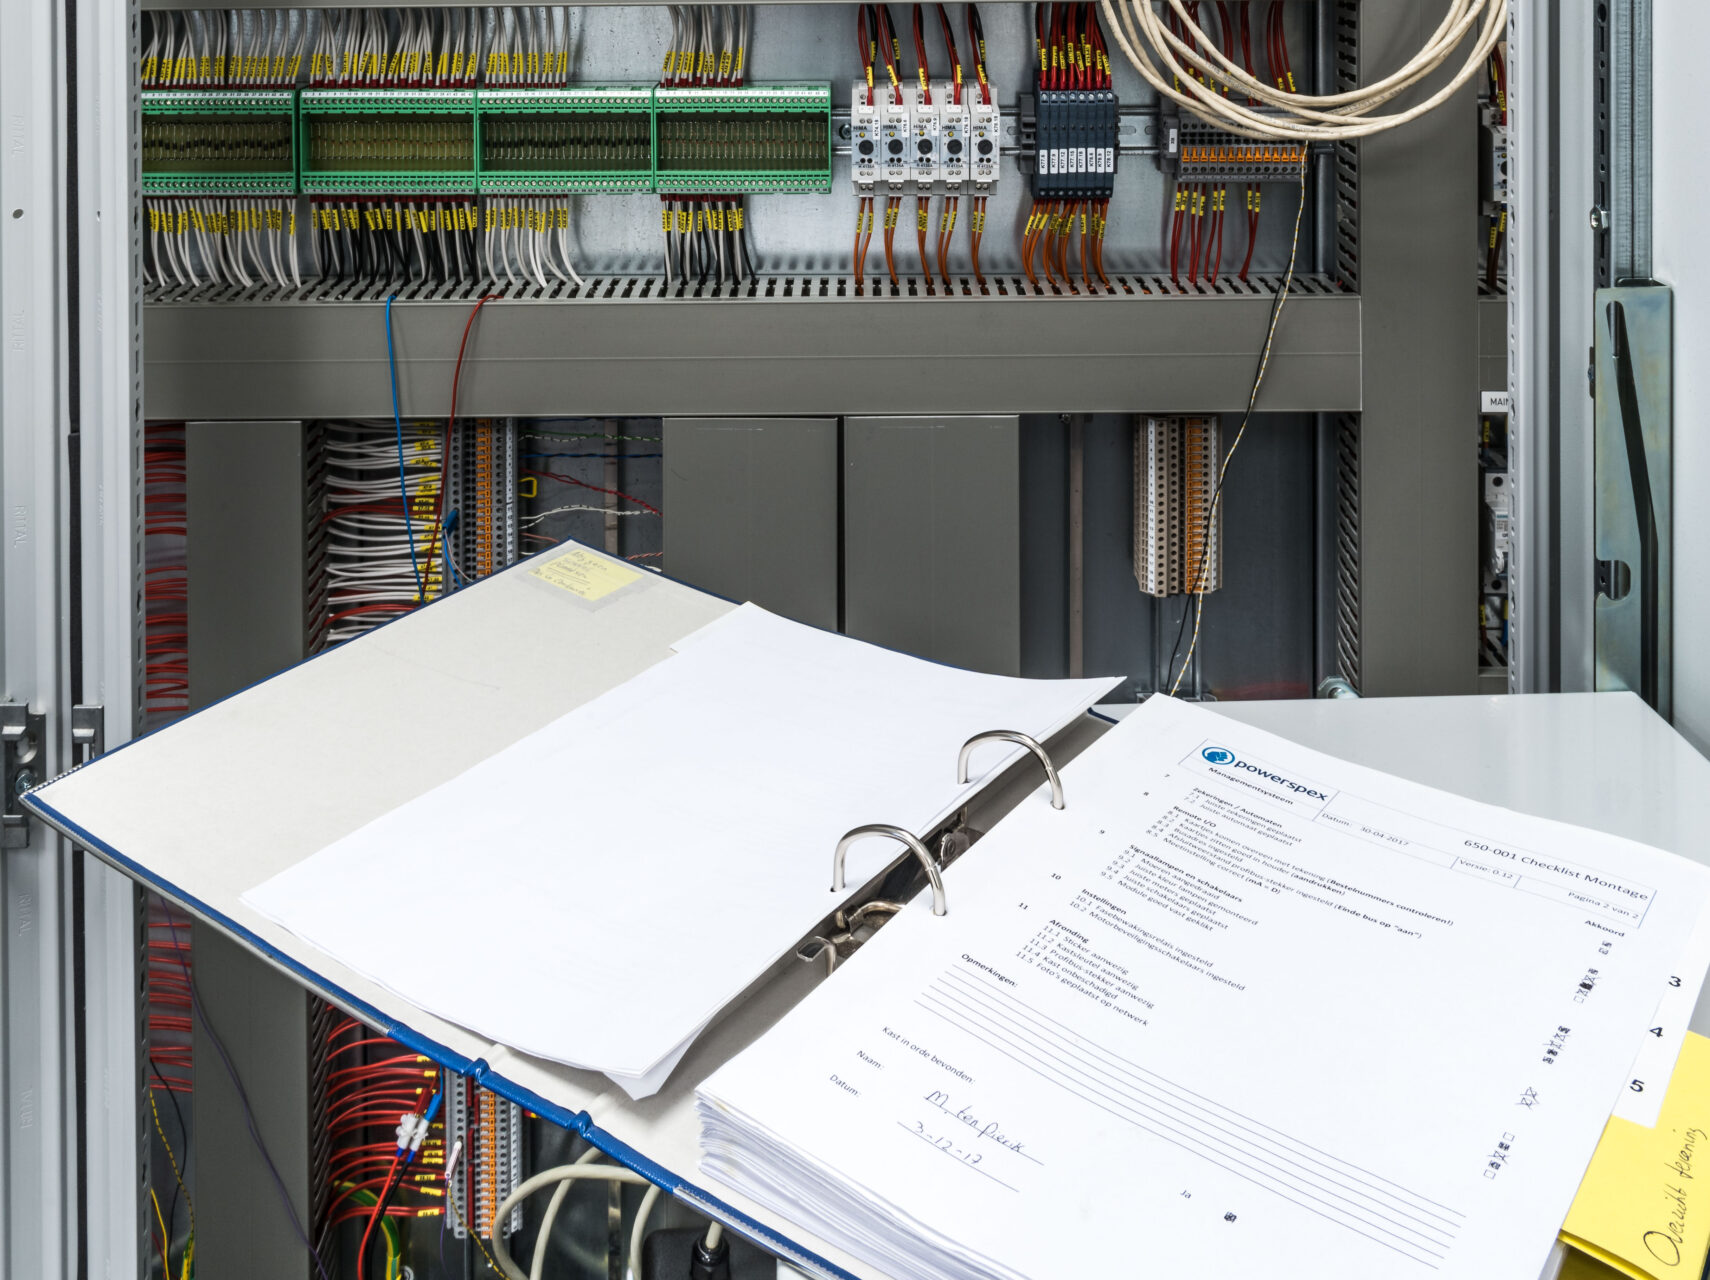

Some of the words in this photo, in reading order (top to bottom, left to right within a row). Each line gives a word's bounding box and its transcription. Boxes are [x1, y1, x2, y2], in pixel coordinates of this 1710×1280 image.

[1207, 766, 1293, 805] Managementsysteem
[1233, 759, 1328, 801] powerspex
[1172, 805, 1202, 821] Remote
[1202, 818, 1217, 828] I/O
[1192, 786, 1233, 807] Zekeringen
[1239, 807, 1282, 828] Automaten
[1321, 812, 1352, 826] Datum:
[1128, 843, 1184, 874] Signaallampen
[1196, 877, 1242, 903] schakelaars
[1140, 857, 1171, 876] Moeren
[1171, 874, 1220, 900] aangedraaid
[1459, 858, 1488, 871] Versie:
[1491, 869, 1513, 879] 0.12
[1463, 839, 1516, 860] 650-001
[1520, 856, 1580, 878] Checklist
[1583, 873, 1648, 899] Montage
[1080, 888, 1127, 915] Instellingen
[1116, 879, 1148, 898] Module
[1146, 896, 1169, 909] goed
[1168, 906, 1186, 918] vast
[1184, 915, 1214, 932] geklikt
[1122, 874, 1145, 887] Juiste
[1145, 886, 1190, 911] schakelaars
[1189, 909, 1229, 930] geplaatst
[1128, 869, 1151, 882] Juiste
[1150, 880, 1178, 897] meters
[1178, 895, 1216, 916] geplaatst
[1134, 863, 1157, 876] Juiste
[1157, 874, 1177, 887] kleur
[1177, 884, 1207, 903] lampen
[1206, 900, 1259, 926] gemonteerd
[1567, 890, 1601, 906] Pagina
[1611, 906, 1630, 916] van
[1048, 918, 1089, 944] Afronding
[1068, 900, 1087, 912] 10.2
[1088, 910, 1204, 974] Motorbeveiligingsschakelaars
[1205, 970, 1246, 991] ingesteld
[1075, 894, 1093, 906] 10.1
[1095, 904, 1173, 949] Fasebewakingsrelais
[1174, 946, 1214, 968] ingesteld
[1584, 919, 1625, 937] Akkoord
[960, 953, 1018, 987] Opmerkingen:
[1035, 931, 1055, 943] 11.2
[1055, 942, 1101, 969] Kastsleutel
[1099, 967, 1139, 991] aanwezig
[1042, 924, 1061, 937] 11.1
[1062, 935, 1090, 953] Sticker
[1090, 952, 1129, 976] aanwezig
[1015, 950, 1033, 964] 11.5
[1035, 962, 1060, 979] Foto's
[1059, 977, 1100, 1000] geplaatst
[1112, 1005, 1147, 1027] netwerk
[1022, 944, 1041, 957] 11.4
[1042, 955, 1061, 969] Kast
[1060, 966, 1119, 1000] onbeschadigd
[1029, 937, 1048, 950] 11.3
[1049, 948, 1114, 987] Profibus-stekker
[1114, 986, 1155, 1009] aanwezig
[1668, 976, 1682, 988] 3
[1649, 1027, 1664, 1038] 4
[855, 1049, 885, 1071] Naam:
[881, 1025, 901, 1041] Kast
[909, 1043, 930, 1058] orde
[929, 1054, 977, 1083] bevonden:
[828, 1073, 862, 1098] Datum:
[1630, 1079, 1645, 1092] 5
